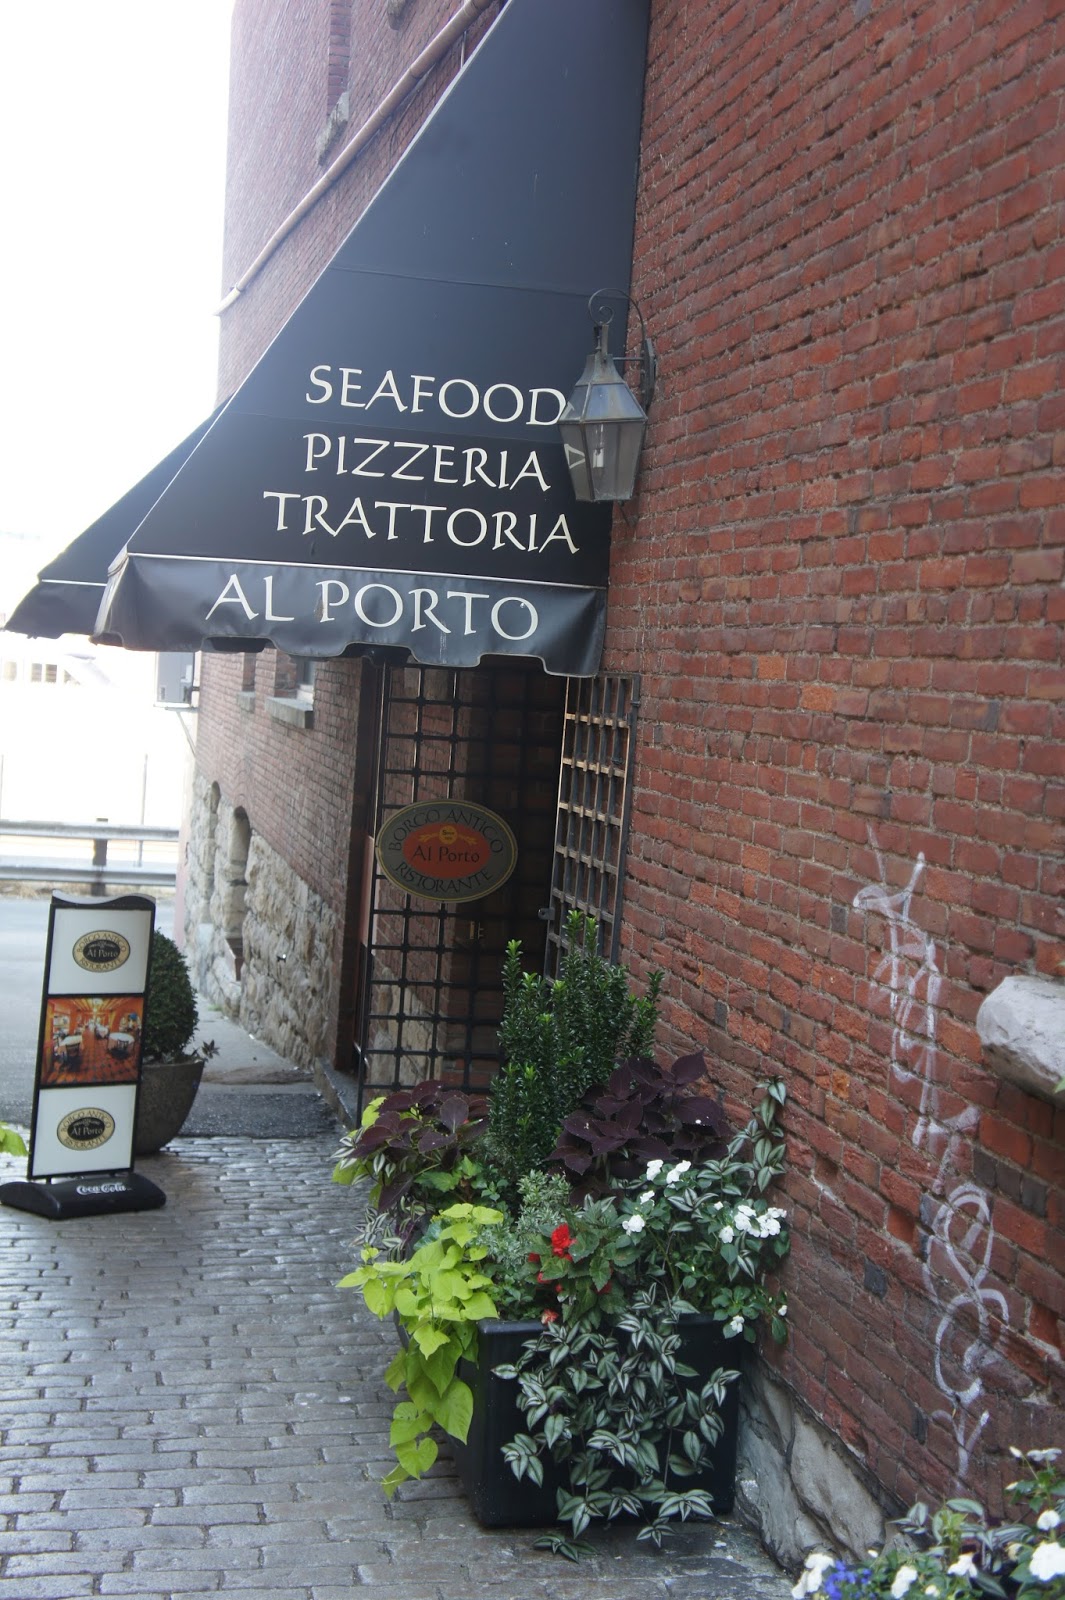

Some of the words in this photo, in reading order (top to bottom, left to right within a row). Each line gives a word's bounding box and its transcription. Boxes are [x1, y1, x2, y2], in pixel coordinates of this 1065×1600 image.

[305, 365, 567, 426] SEAFOOD
[303, 433, 551, 492] PIZZERIA
[263, 491, 580, 555] TRATTORIA
[205, 574, 294, 621] AL
[315, 580, 539, 641] PORTO
[388, 809, 441, 851] BORGO
[445, 809, 504, 853] ANTICO
[411, 845, 431, 862] Al
[438, 846, 480, 863] Porto
[394, 861, 493, 893] RISTORANTE
[87, 948, 97, 958] Al
[98, 949, 119, 958] Porto
[71, 1126, 80, 1136] Al
[82, 1126, 103, 1136] Porto
